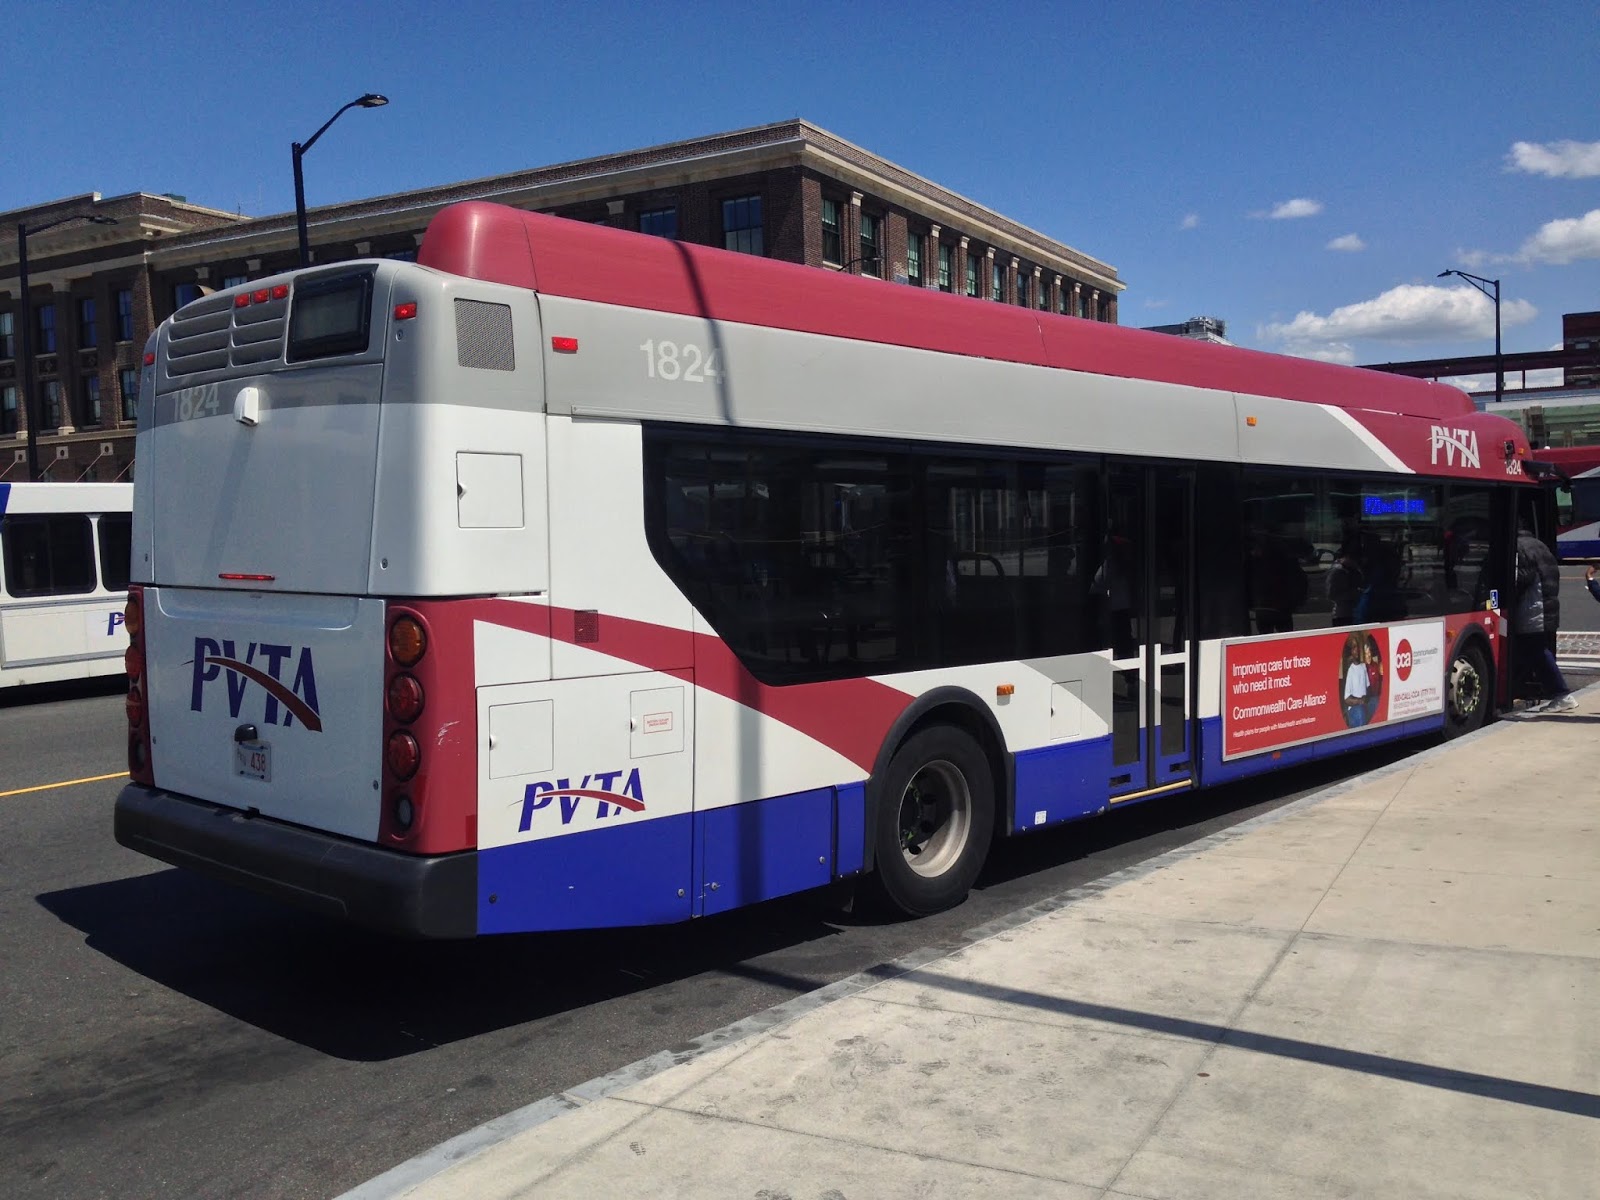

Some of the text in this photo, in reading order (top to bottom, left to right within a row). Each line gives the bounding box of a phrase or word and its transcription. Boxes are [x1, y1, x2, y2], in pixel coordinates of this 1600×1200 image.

[640, 339, 725, 384] 1824
[172, 384, 220, 422] 1824
[1430, 425, 1481, 469] PVTA
[1232, 655, 1311, 678] Improving care for those
[1396, 652, 1411, 668] cca
[186, 636, 322, 733] PVTA
[1232, 674, 1292, 695] who need it most.
[1232, 699, 1286, 720] Commonwealth
[1287, 696, 1302, 711] Care
[518, 767, 646, 833] PVTA
